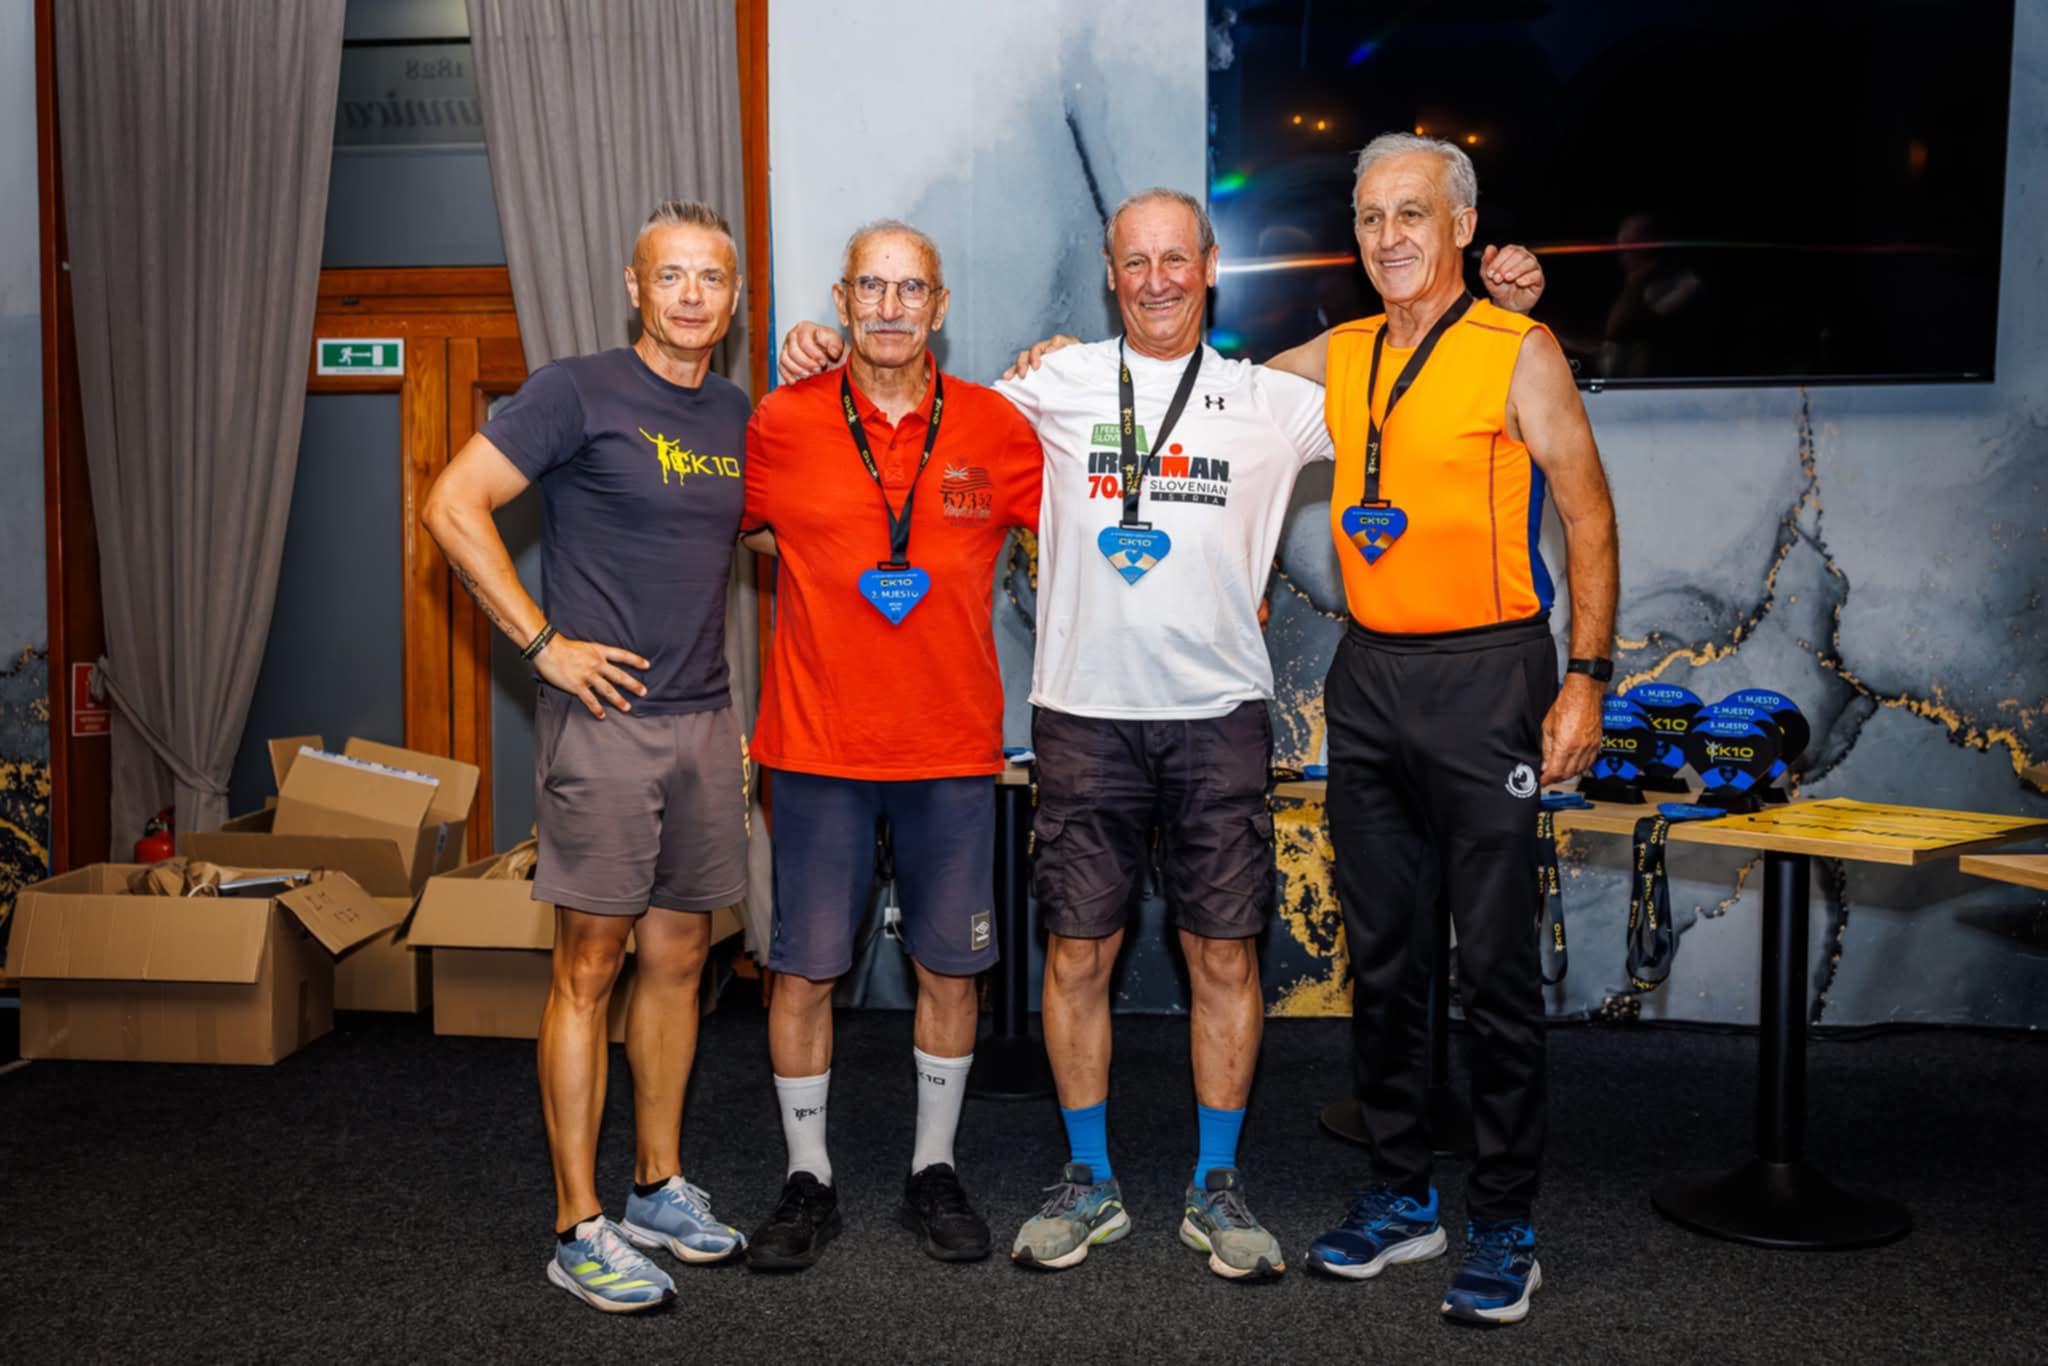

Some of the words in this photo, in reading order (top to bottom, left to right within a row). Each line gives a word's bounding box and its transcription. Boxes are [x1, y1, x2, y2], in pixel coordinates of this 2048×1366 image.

[669, 451, 740, 478] CK10
[1088, 444, 1230, 483] IRNMAN
[1088, 475, 1142, 499] 70.
[1150, 480, 1228, 496] SLOVENIAN
[1159, 492, 1219, 504] ISTRIA
[1648, 689, 1683, 699] MJESTO
[1746, 696, 1780, 705] MJESTO
[1722, 707, 1755, 716] MJESTO
[1650, 718, 1688, 731] K10
[1718, 722, 1748, 730] MJESTO
[1706, 745, 1754, 758] CK10
